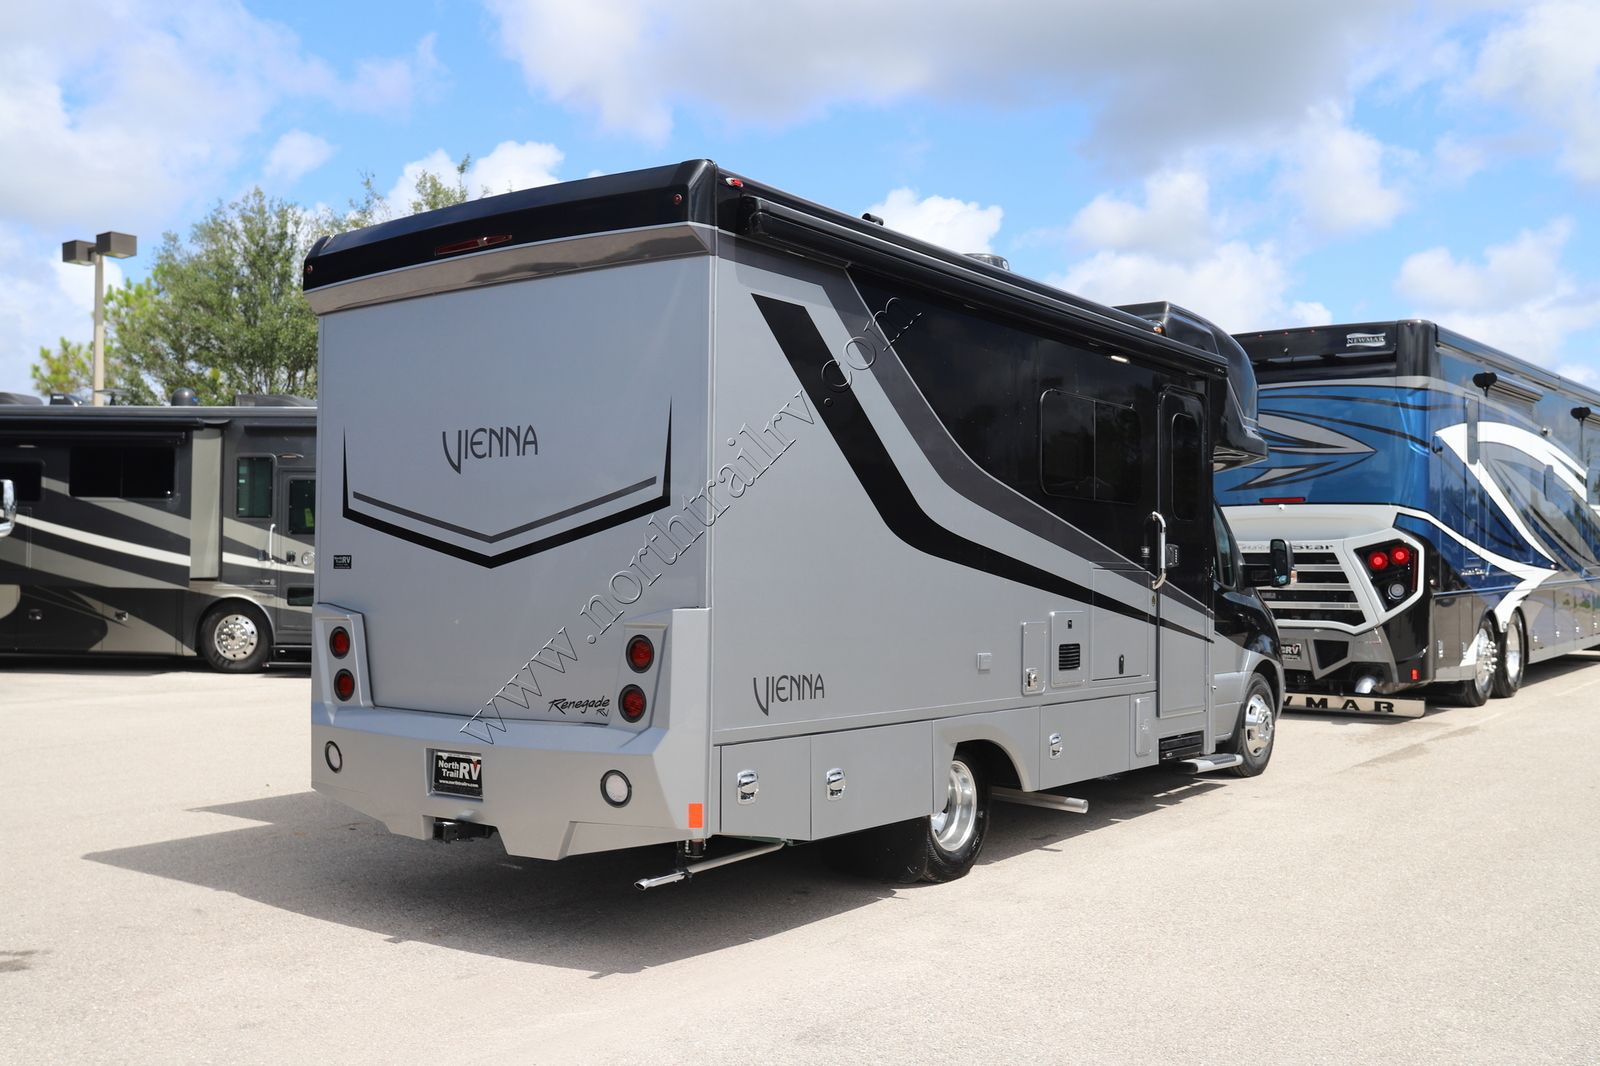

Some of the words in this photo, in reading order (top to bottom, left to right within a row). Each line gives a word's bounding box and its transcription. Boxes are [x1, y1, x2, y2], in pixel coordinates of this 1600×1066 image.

[1347, 336, 1385, 345] NEWMAR
[442, 424, 539, 474] VIENNA
[753, 673, 825, 716] VIENNA
[548, 695, 610, 715] Renegade
[438, 760, 460, 770] North
[442, 768, 459, 778] Trail
[459, 762, 481, 781] RV
